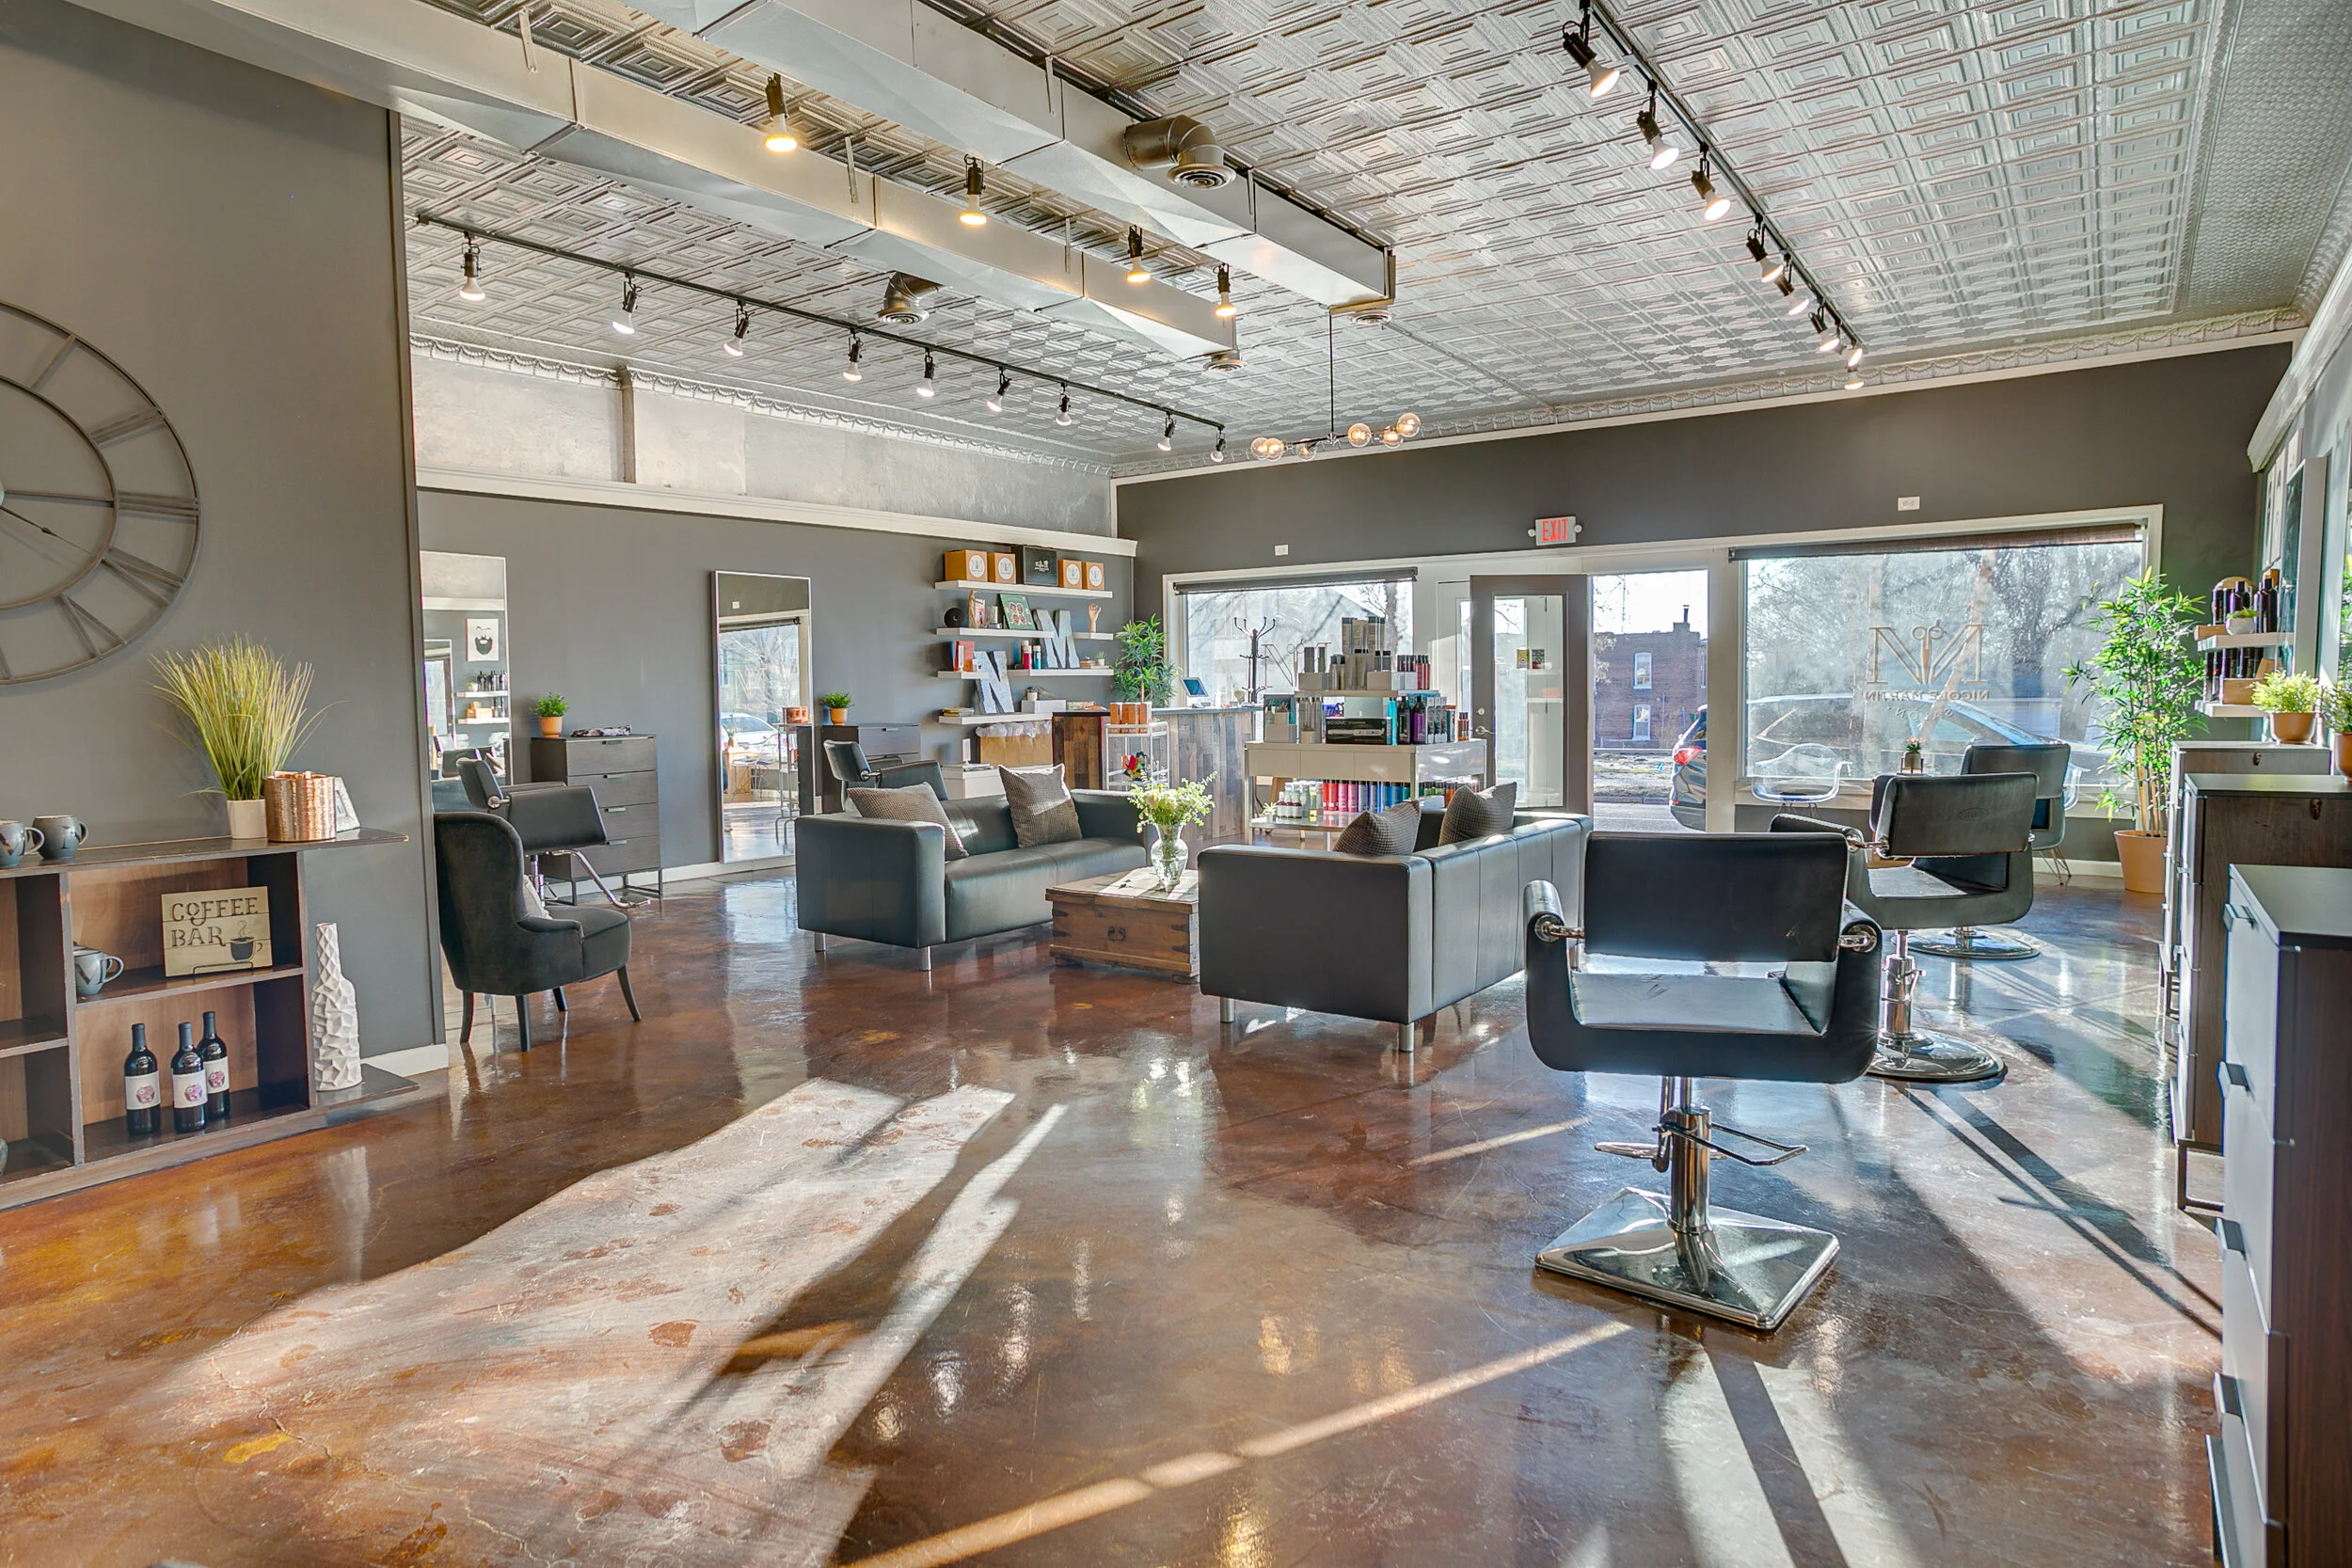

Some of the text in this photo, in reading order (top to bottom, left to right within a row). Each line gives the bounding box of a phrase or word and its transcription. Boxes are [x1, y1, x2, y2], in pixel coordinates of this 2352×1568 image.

[1542, 518, 1568, 543] EXIT
[1035, 610, 1080, 669] M
[974, 651, 1015, 713] N
[171, 896, 259, 926] COFFEE
[171, 926, 226, 947] BAR
